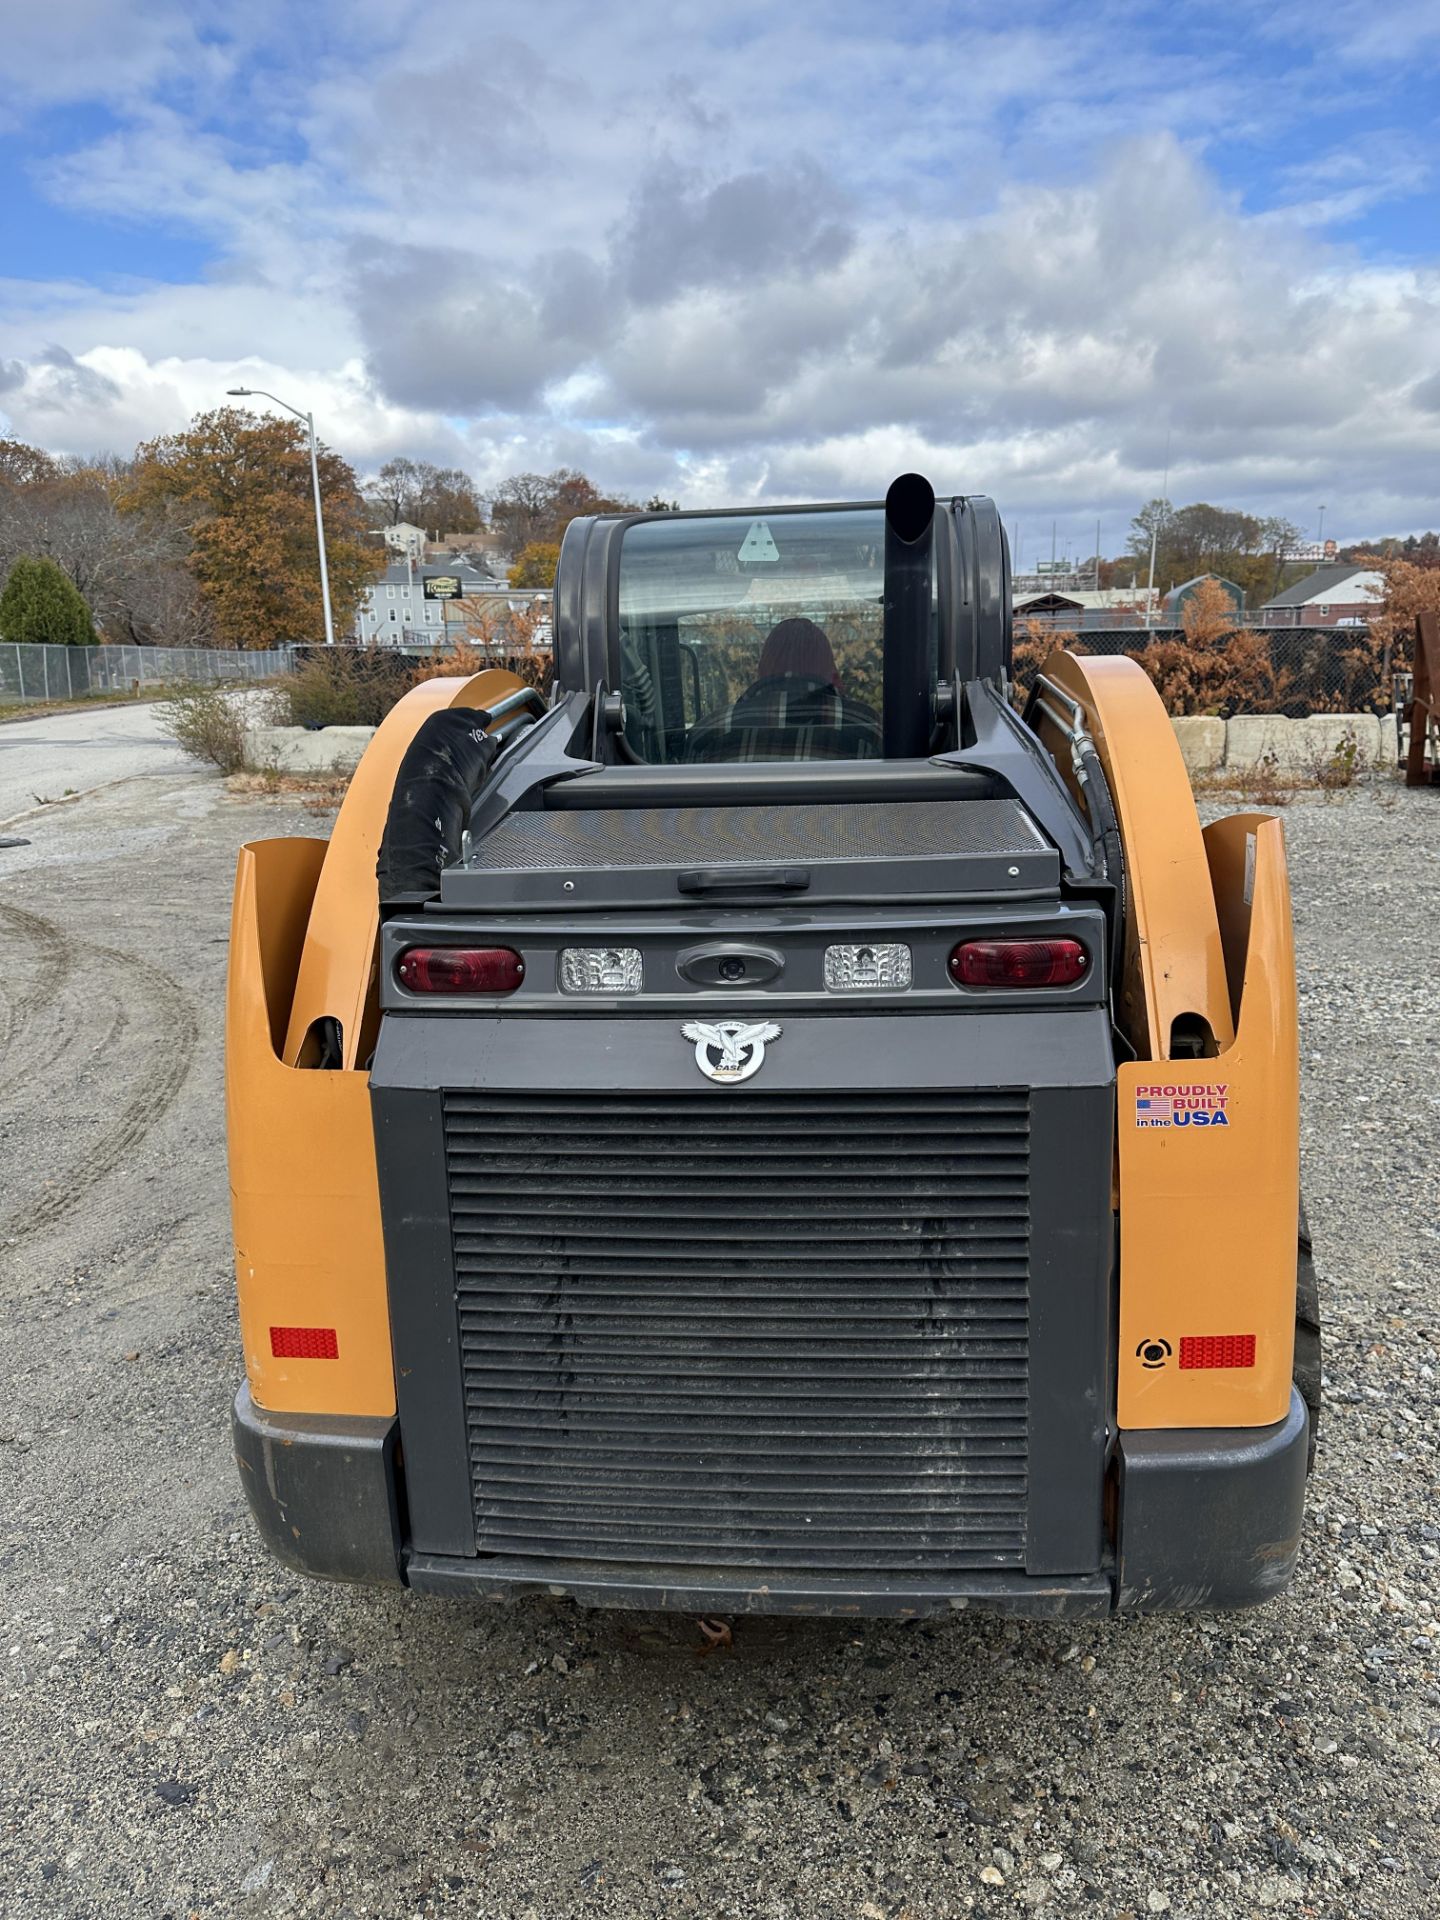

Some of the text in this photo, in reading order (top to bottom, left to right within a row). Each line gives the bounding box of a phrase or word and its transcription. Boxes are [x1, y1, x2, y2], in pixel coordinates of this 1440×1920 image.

[1136, 1085, 1227, 1097] PROUDLY
[1173, 1098, 1228, 1109] BUILT
[1136, 1111, 1228, 1127] in the USA
